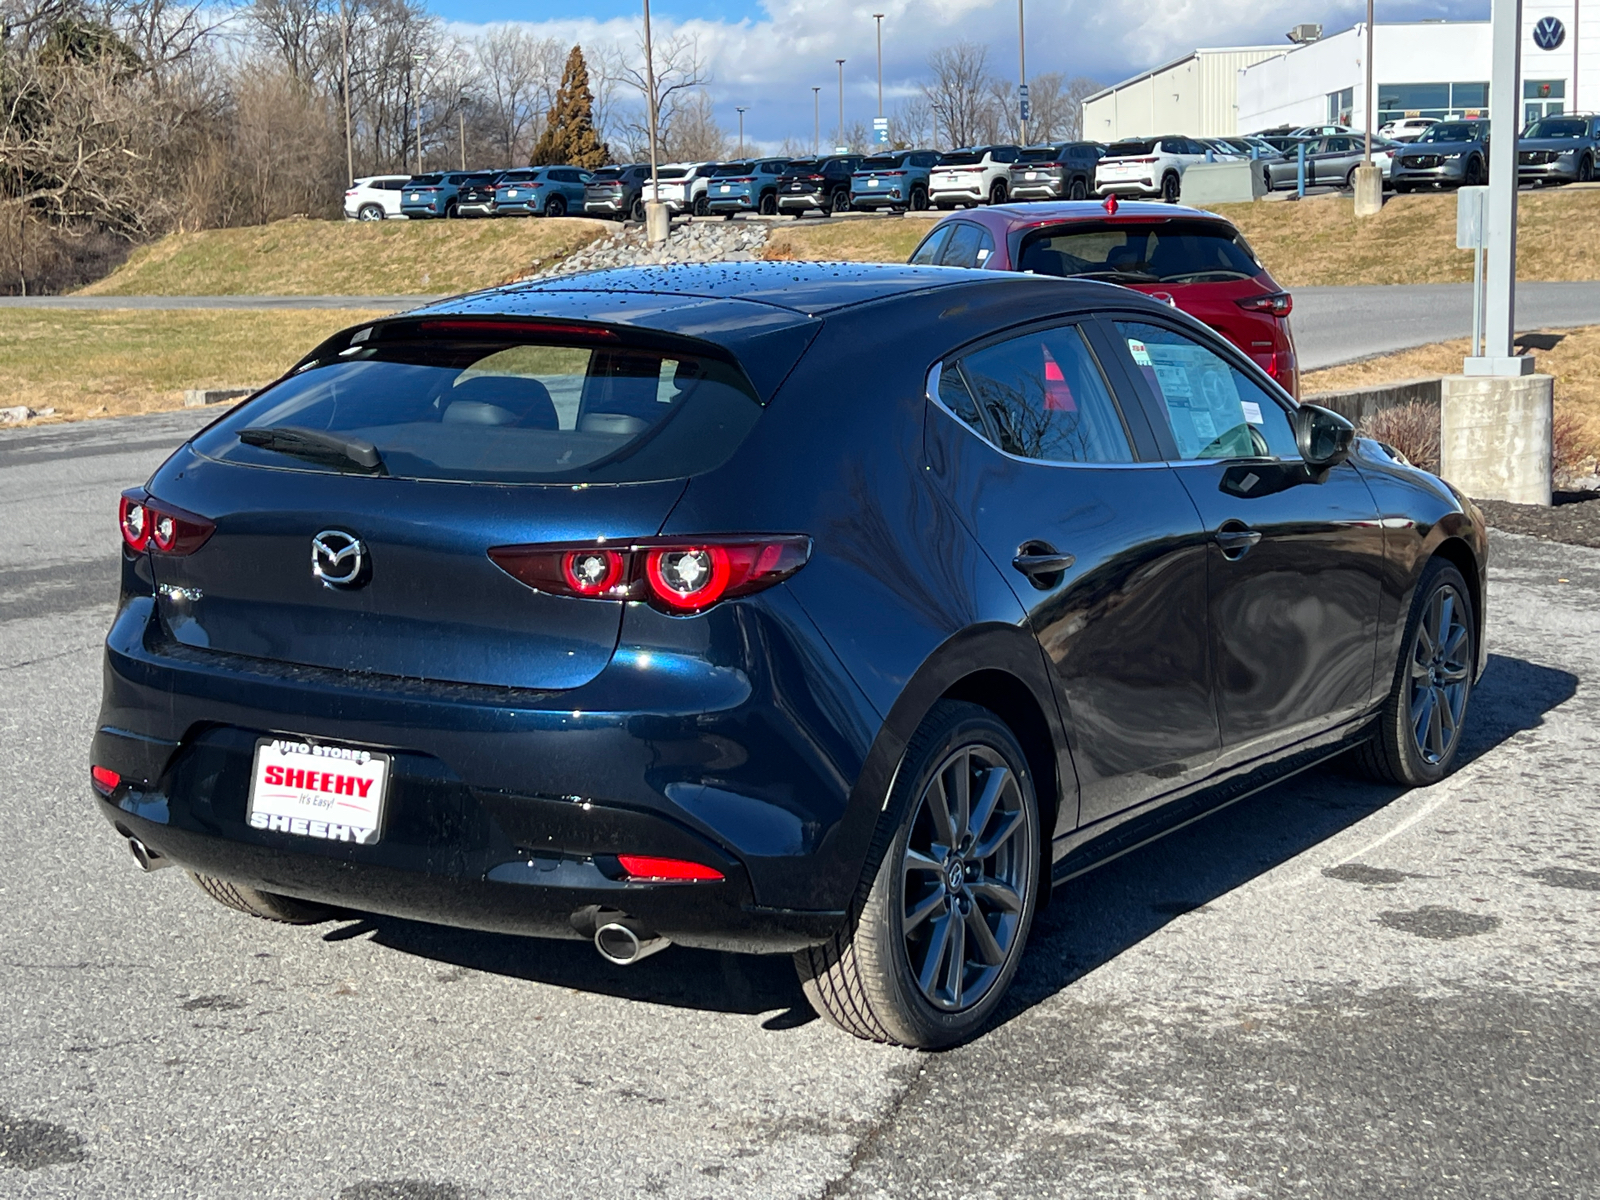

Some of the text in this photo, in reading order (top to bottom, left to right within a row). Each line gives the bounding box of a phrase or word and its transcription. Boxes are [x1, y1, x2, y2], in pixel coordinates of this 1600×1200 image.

[1534, 17, 1564, 48] VW
[313, 745, 371, 762] STORES
[264, 765, 374, 798] SHEEHY
[298, 793, 335, 811] It's Easy!
[250, 812, 373, 844] SHEEHY
